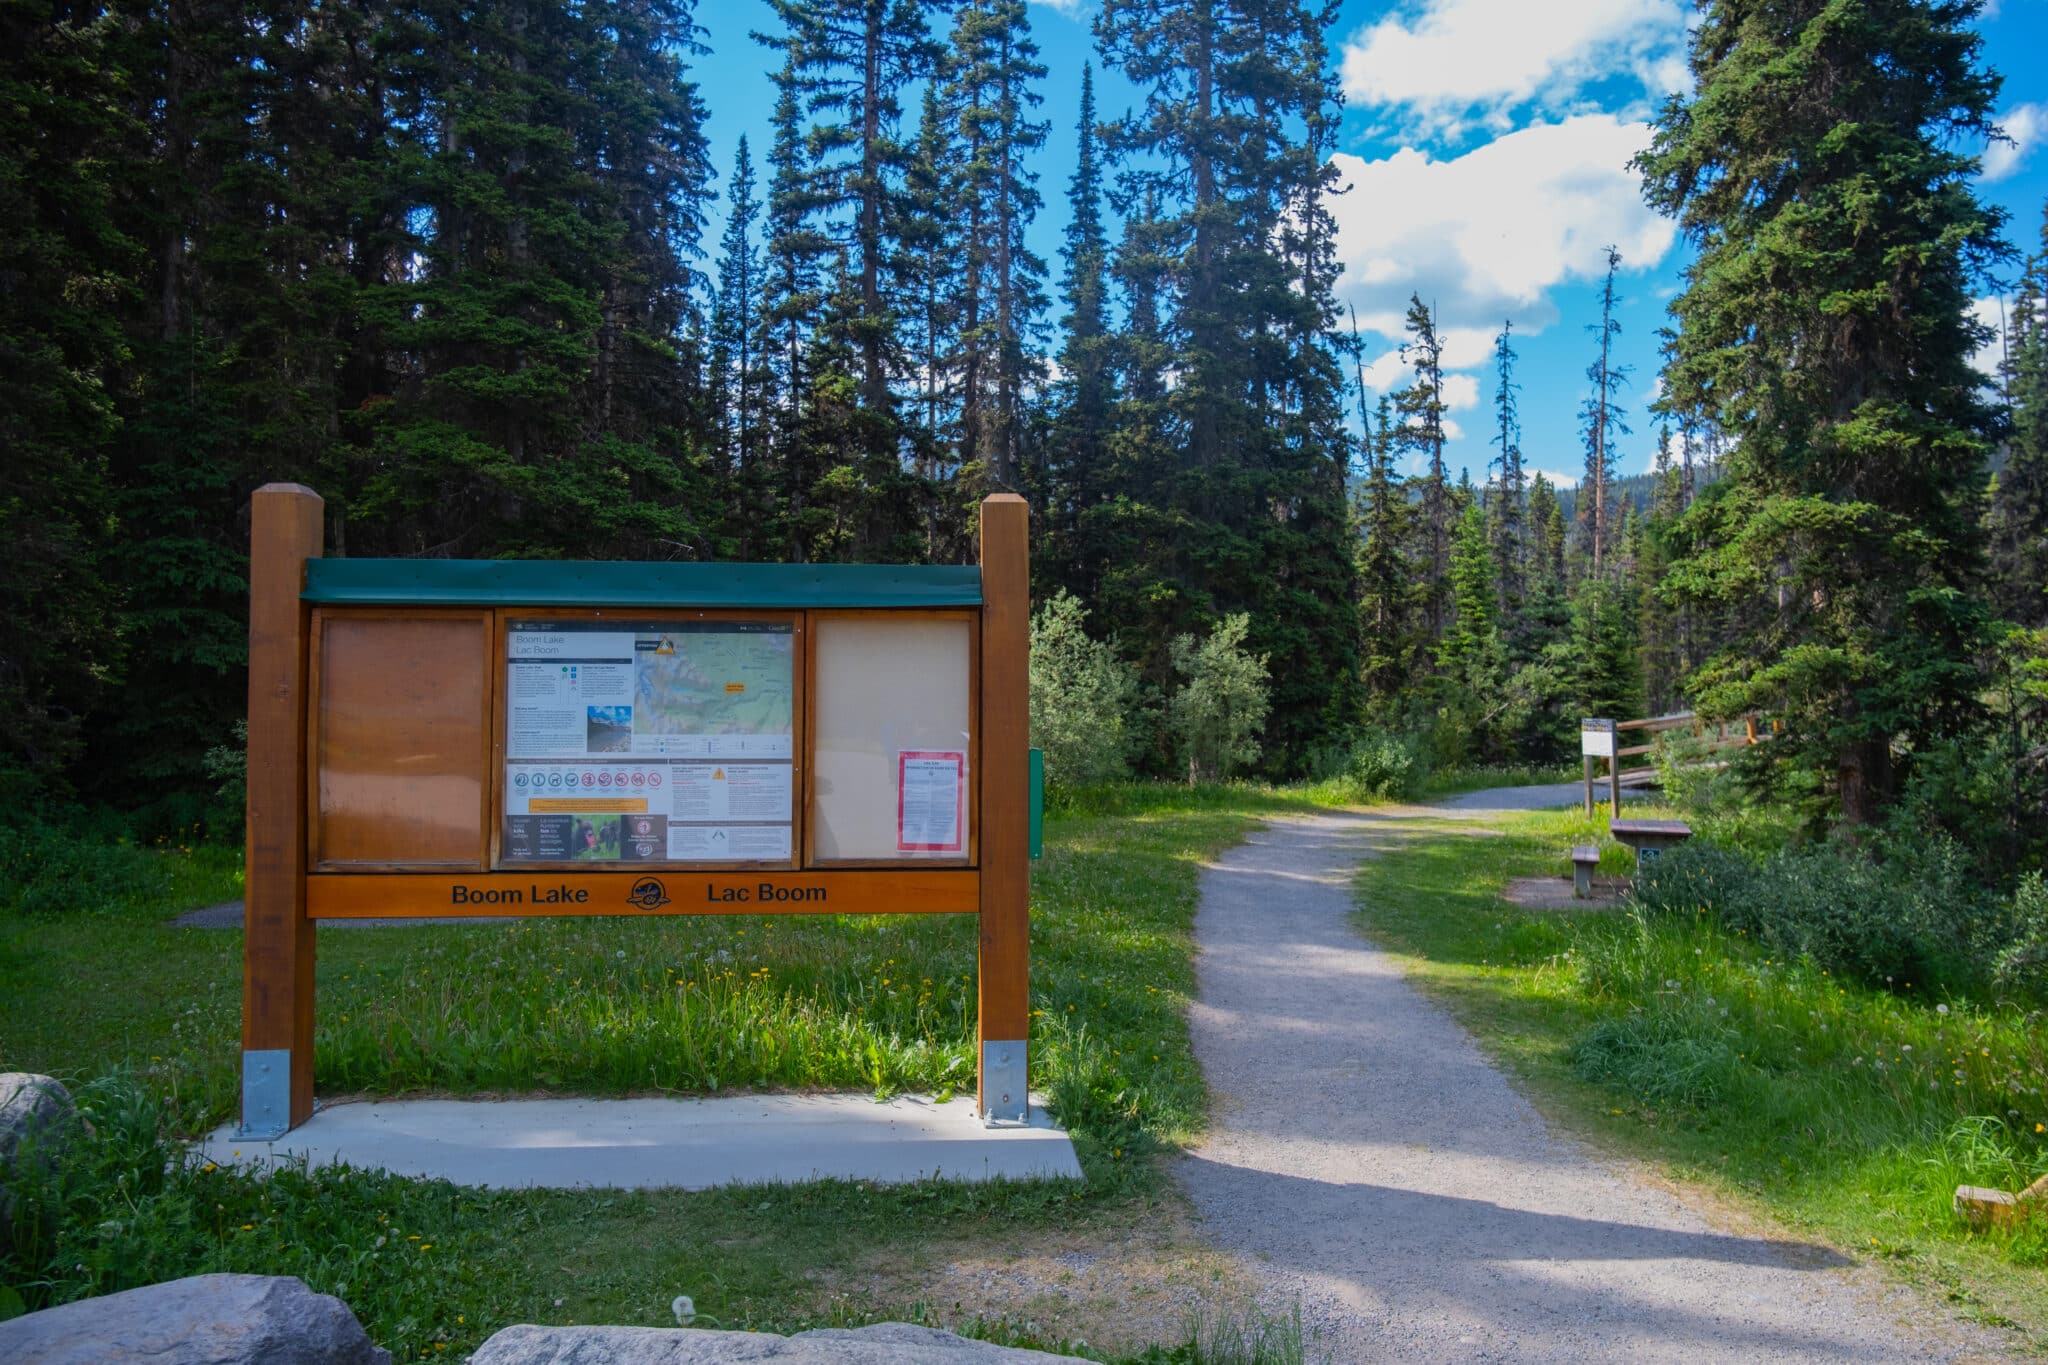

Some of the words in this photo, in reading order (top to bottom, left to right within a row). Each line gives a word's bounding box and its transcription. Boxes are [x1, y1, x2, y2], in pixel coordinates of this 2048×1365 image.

[516, 634, 541, 643] Boom
[544, 635, 565, 644] Lake
[516, 646, 532, 654] Lac
[534, 645, 559, 654] Boom
[452, 885, 522, 904] Boom
[531, 884, 589, 904] Lake
[708, 883, 750, 902] Lac
[758, 883, 827, 902] Boom
